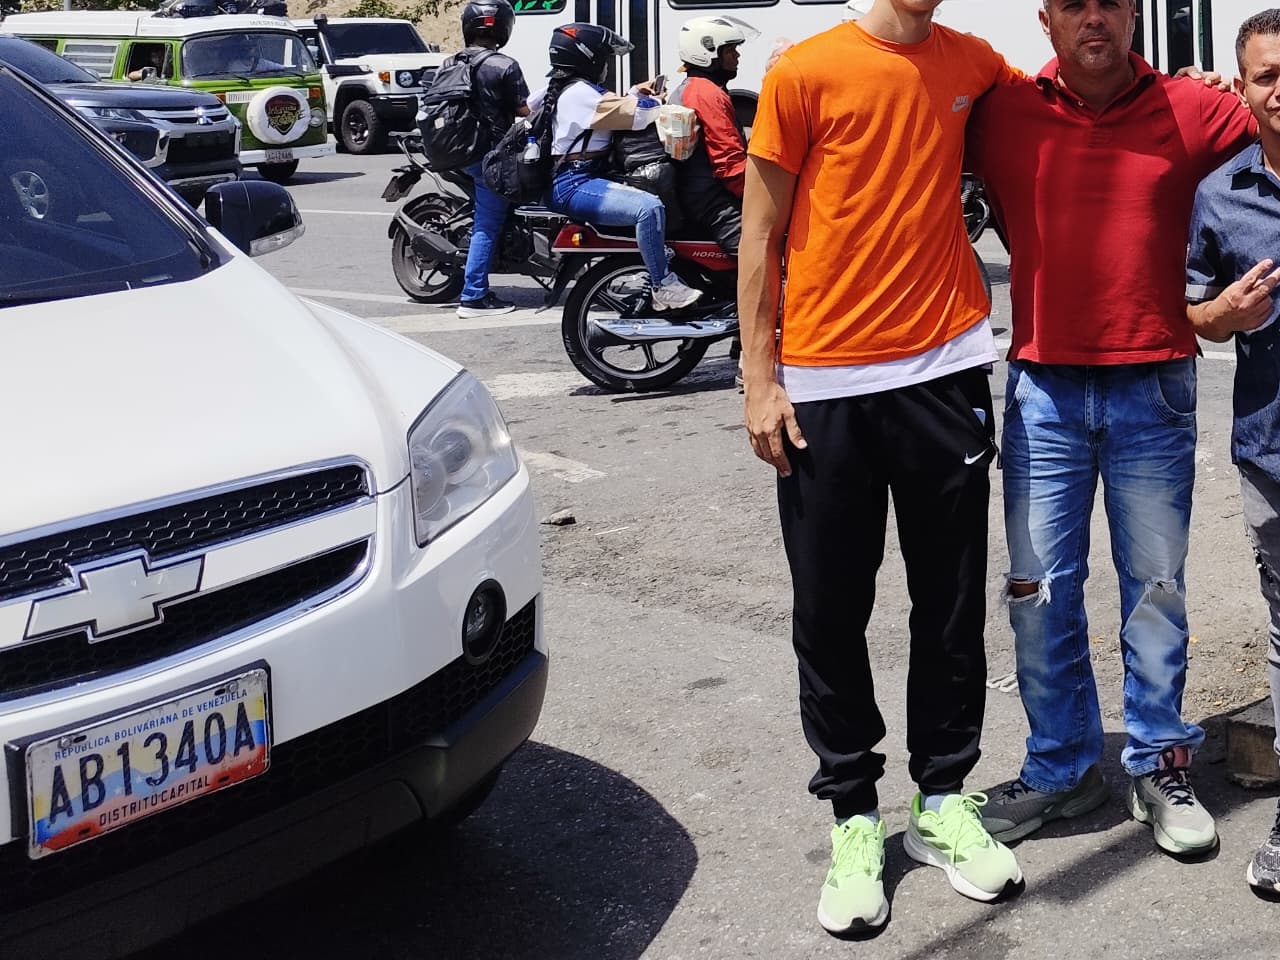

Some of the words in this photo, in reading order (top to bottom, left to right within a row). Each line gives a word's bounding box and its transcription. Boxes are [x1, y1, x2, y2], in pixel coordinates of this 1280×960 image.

[48, 701, 256, 825] AB1340A
[54, 735, 111, 761] REPUBLICA
[114, 712, 179, 741] BOLIVARIANA
[182, 707, 194, 719] DE
[196, 688, 248, 713] VENEZUELA
